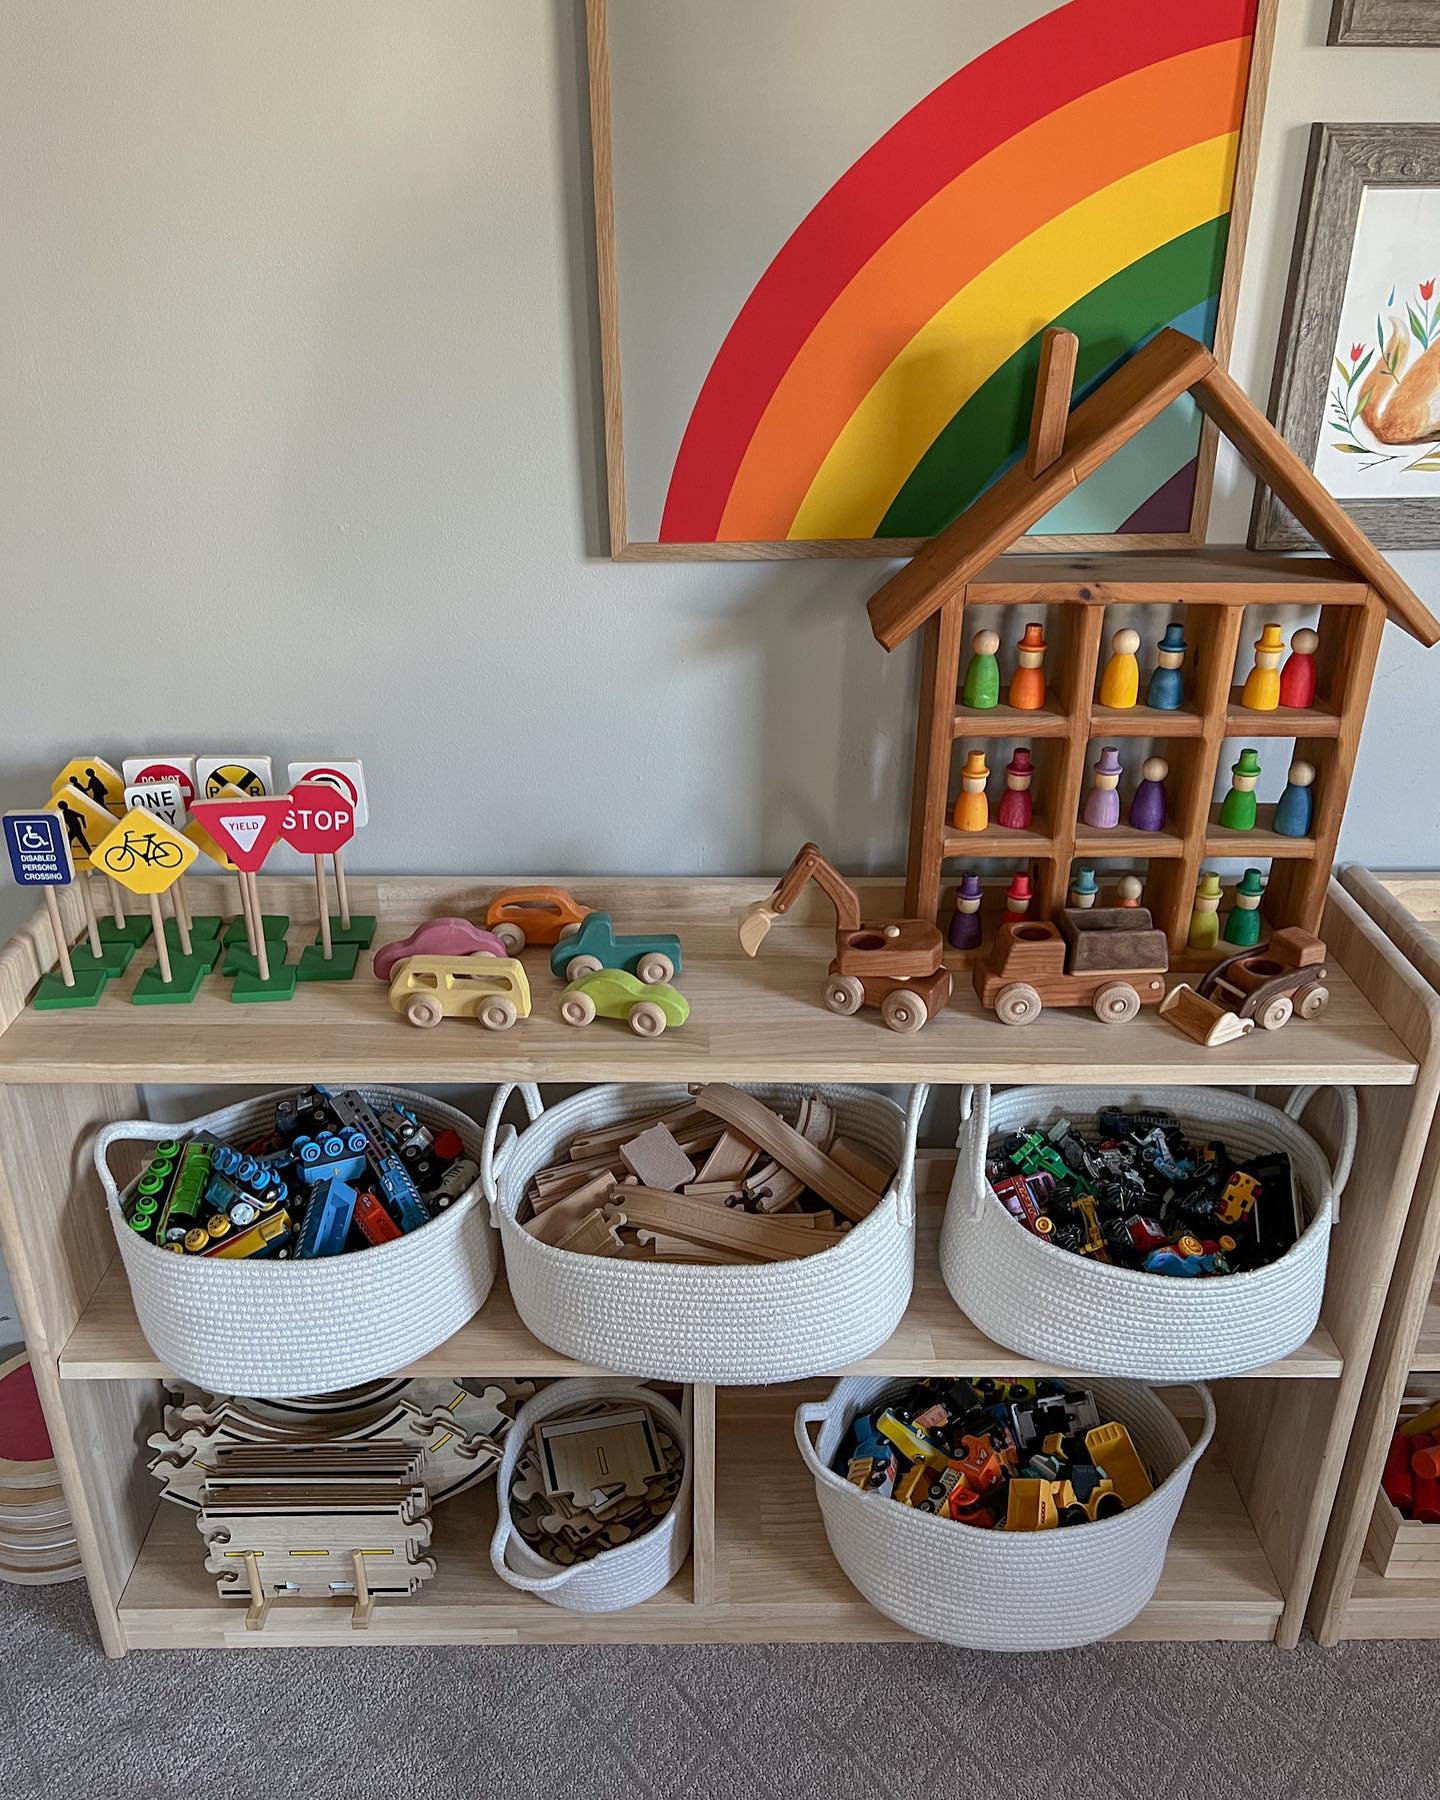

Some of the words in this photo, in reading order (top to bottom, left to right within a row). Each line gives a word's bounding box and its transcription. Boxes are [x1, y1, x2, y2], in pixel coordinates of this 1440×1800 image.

[131, 790, 175, 809] ONE
[282, 809, 350, 831] STOP
[228, 822, 260, 832] YIELD
[20, 854, 57, 862] DISABLED
[22, 863, 58, 871] PERSONS
[24, 872, 63, 880] CROSSING
